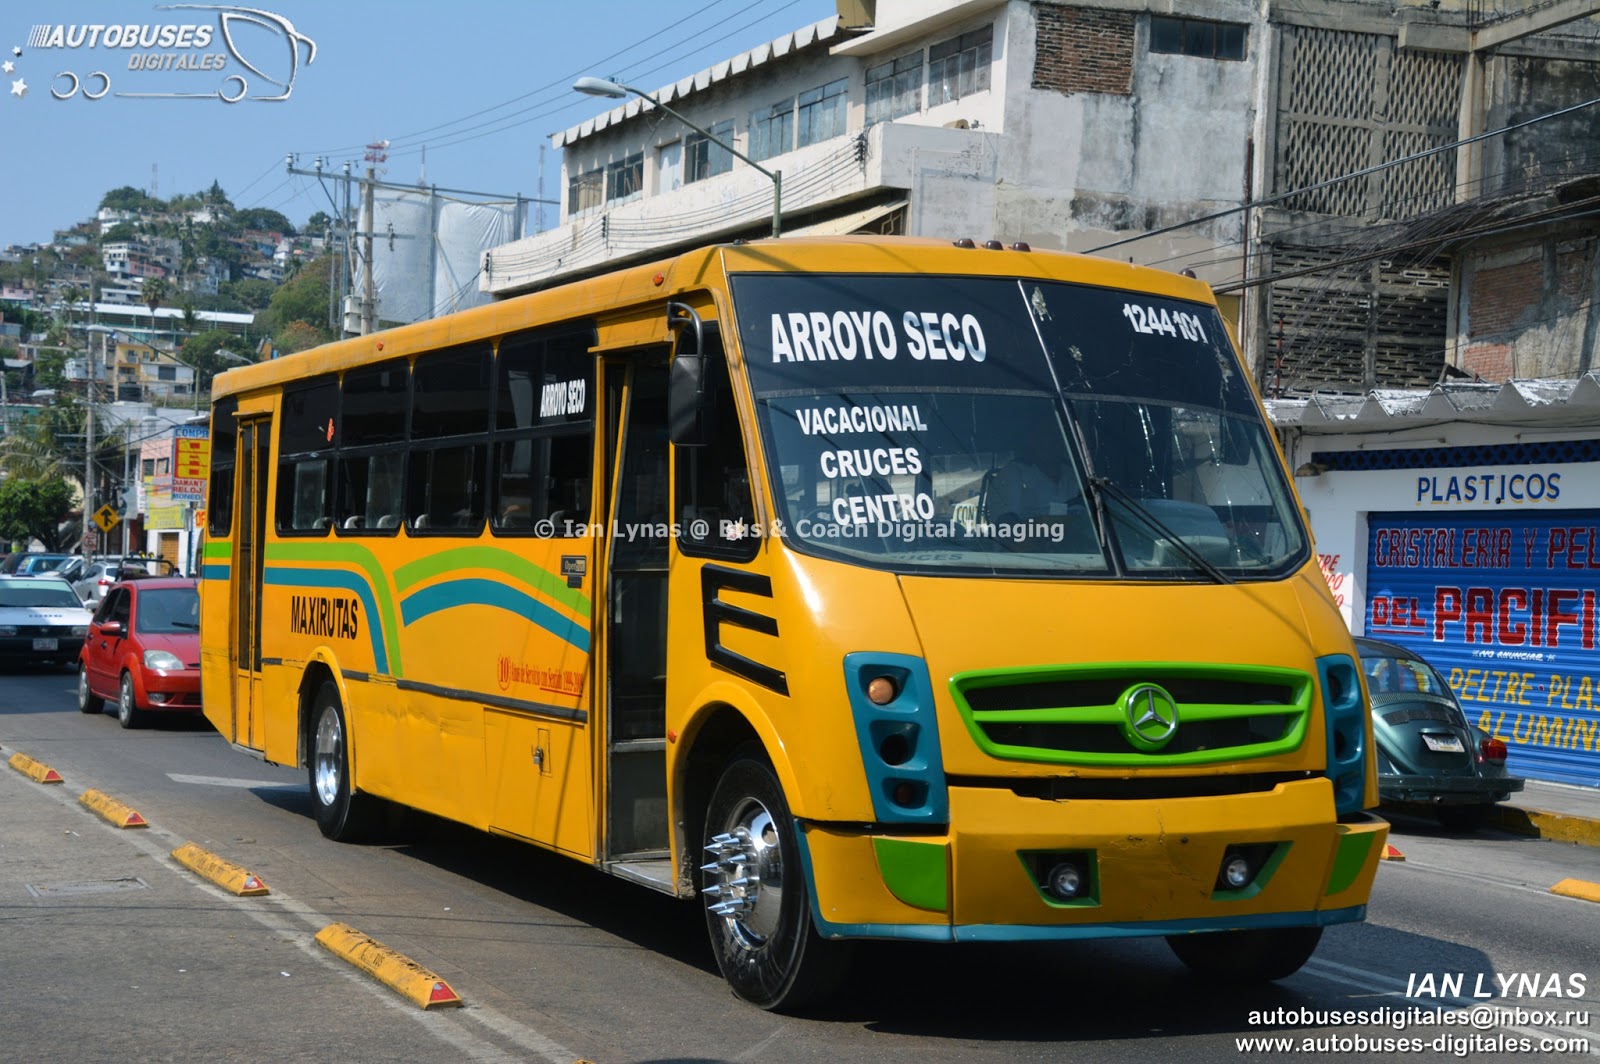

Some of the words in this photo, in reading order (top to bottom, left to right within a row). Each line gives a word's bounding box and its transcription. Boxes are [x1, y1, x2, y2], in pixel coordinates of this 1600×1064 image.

[771, 310, 897, 363] ARROYO
[903, 311, 988, 363] SECO
[540, 382, 568, 417] ARROYO
[567, 378, 586, 414] SECO
[796, 404, 928, 436] VACACIONAL
[820, 447, 922, 478] CRUCES
[1416, 473, 1561, 503] PLASTICOS
[833, 492, 935, 526] CENTRO
[1375, 528, 1512, 568] CRISTALERIA
[1523, 528, 1537, 569] Y
[1546, 527, 1600, 569] PEL
[291, 595, 358, 640] MAXIRUTAS
[1371, 596, 1427, 628] DEL
[1433, 585, 1600, 650] PACIFI
[1497, 651, 1544, 661] ANUNCIAR
[1477, 710, 1600, 752] ALUMIN
